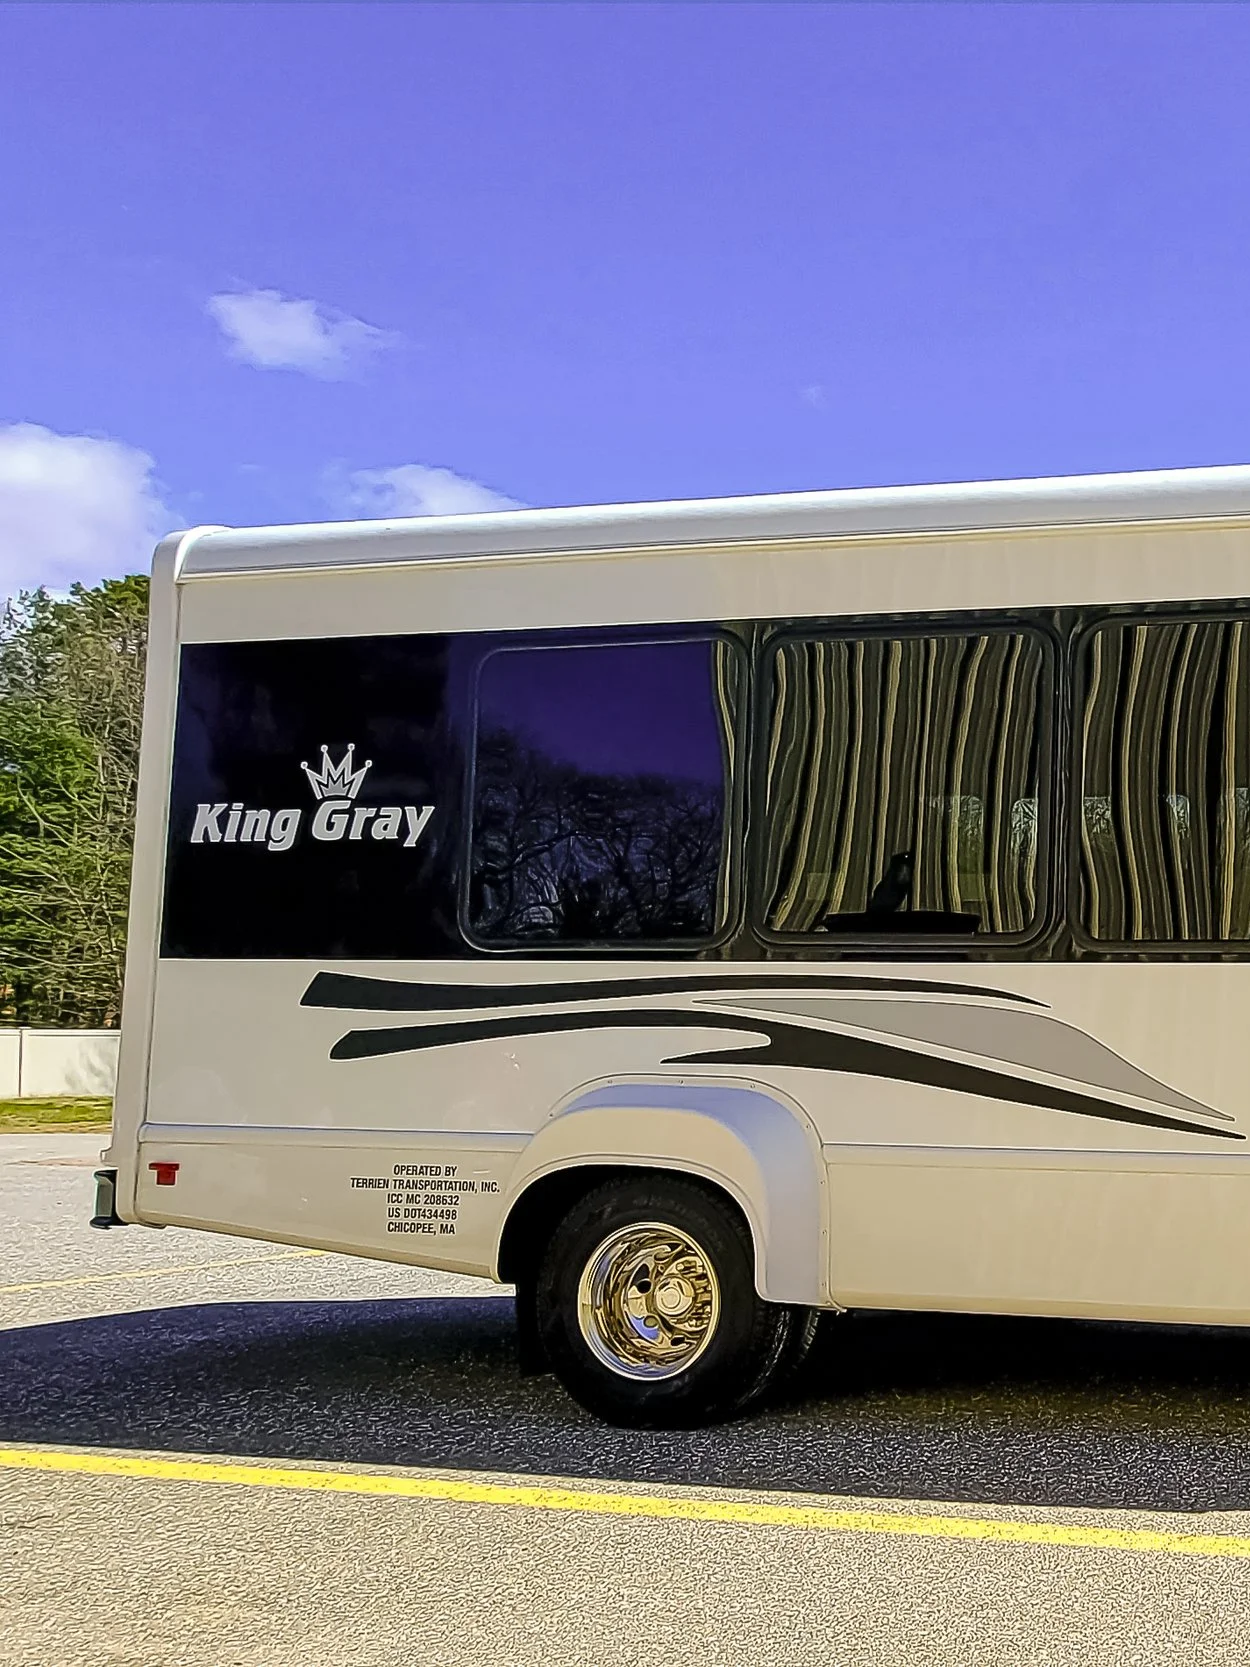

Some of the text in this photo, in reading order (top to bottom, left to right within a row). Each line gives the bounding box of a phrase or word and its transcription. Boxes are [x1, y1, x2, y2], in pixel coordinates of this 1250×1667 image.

[190, 800, 436, 851] King Gray
[393, 1164, 458, 1177] OPERATED BY
[350, 1177, 501, 1194] TERRIEN TRANSPORTATION, INC.
[387, 1193, 460, 1206] ICC MC 208632
[387, 1207, 458, 1221] US DOT434498
[387, 1221, 456, 1236] CHICOPEE, MA
